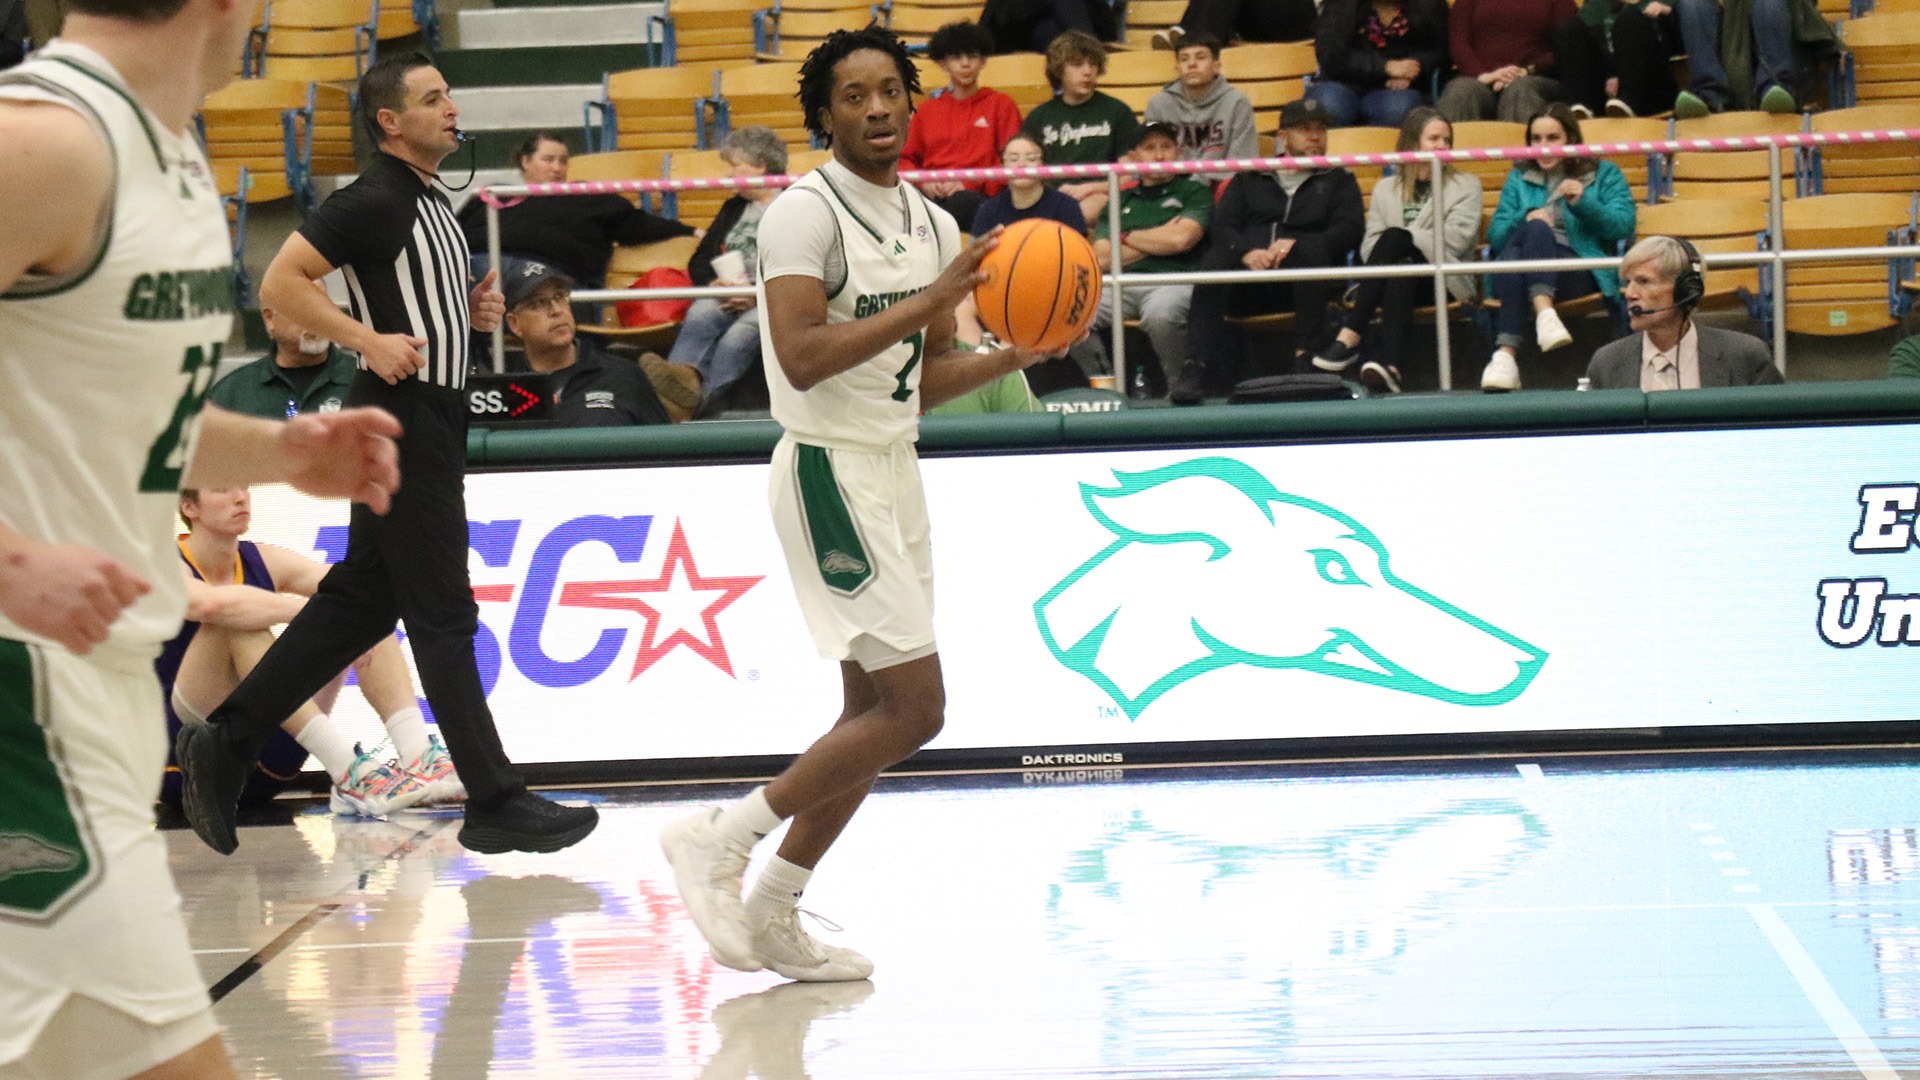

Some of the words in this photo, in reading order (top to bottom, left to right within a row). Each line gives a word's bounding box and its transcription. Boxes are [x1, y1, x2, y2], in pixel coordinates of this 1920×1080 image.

[1046, 400, 1121, 415] ENMU
[1849, 481, 1920, 554] E
[1022, 753, 1123, 765] DAKTRONICS
